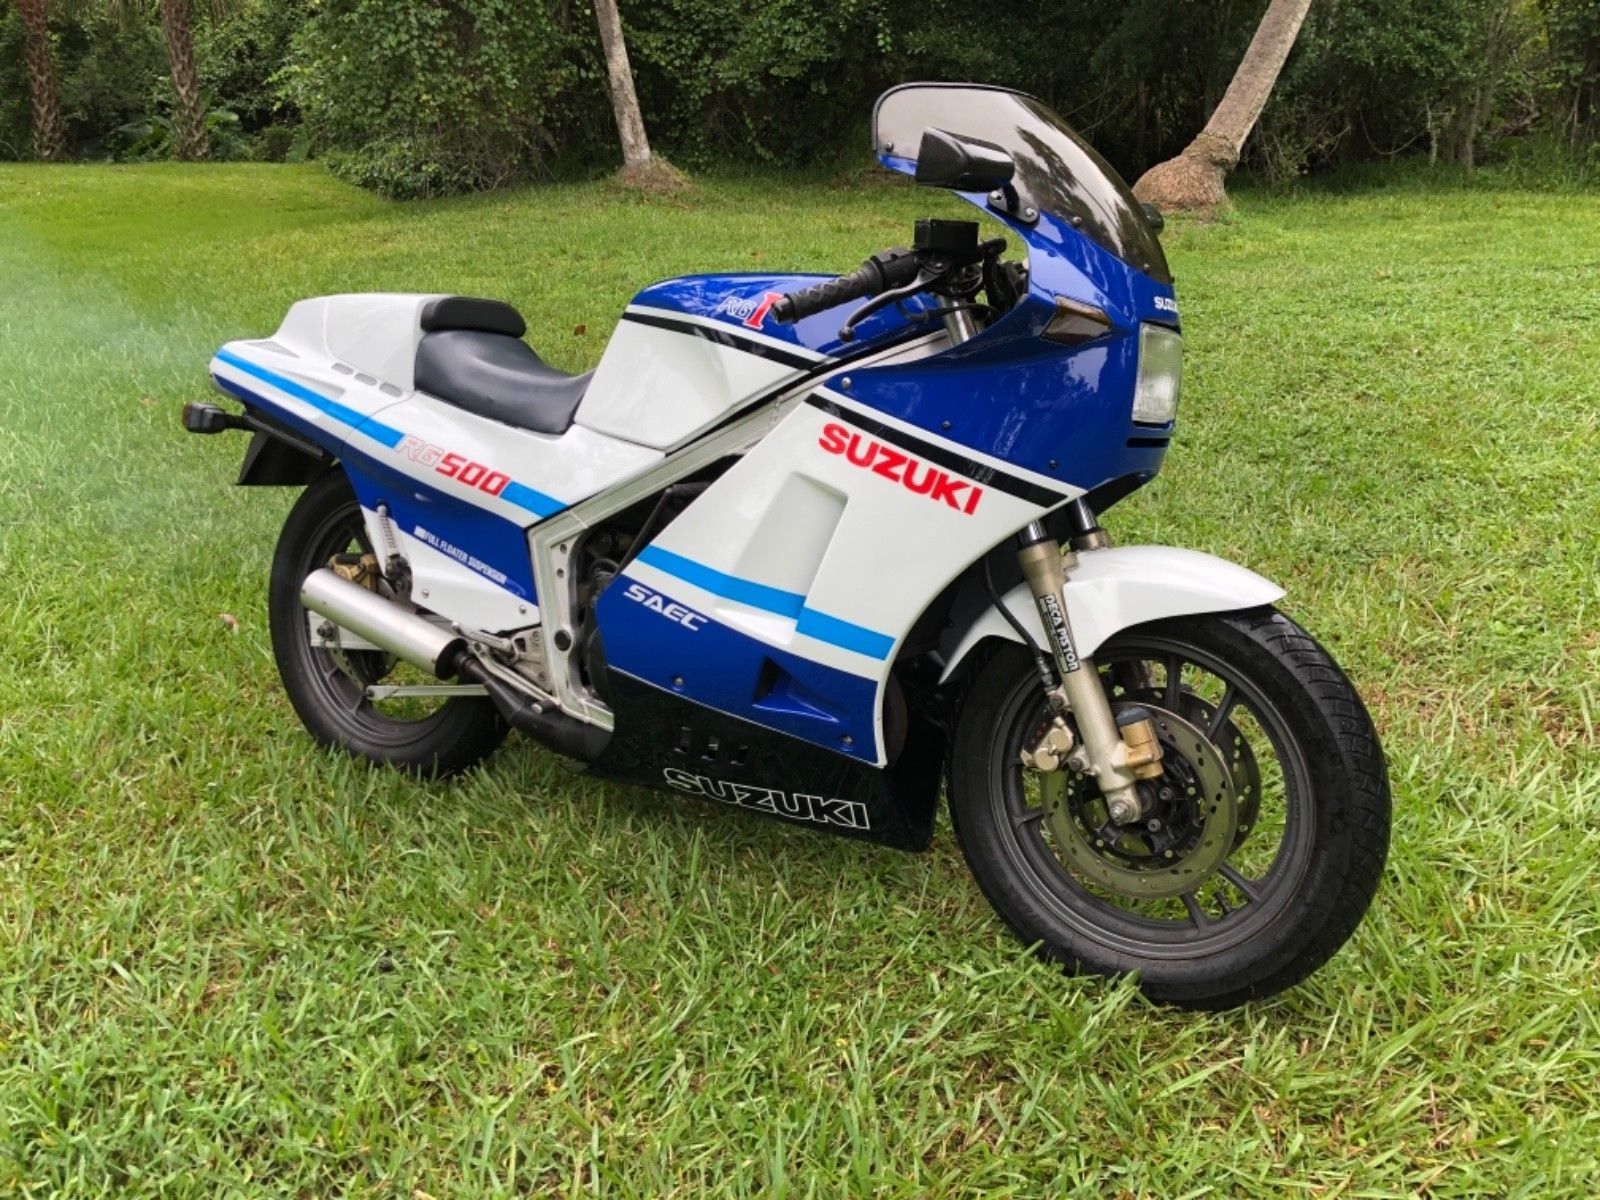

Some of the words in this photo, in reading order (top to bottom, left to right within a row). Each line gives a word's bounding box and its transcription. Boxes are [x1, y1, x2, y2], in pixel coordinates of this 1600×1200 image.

[396, 434, 512, 497] RG500
[818, 422, 984, 516] SUZUKI
[623, 584, 709, 631] SAEC
[1044, 594, 1062, 627] DECA
[663, 768, 871, 830] SUZUKI
